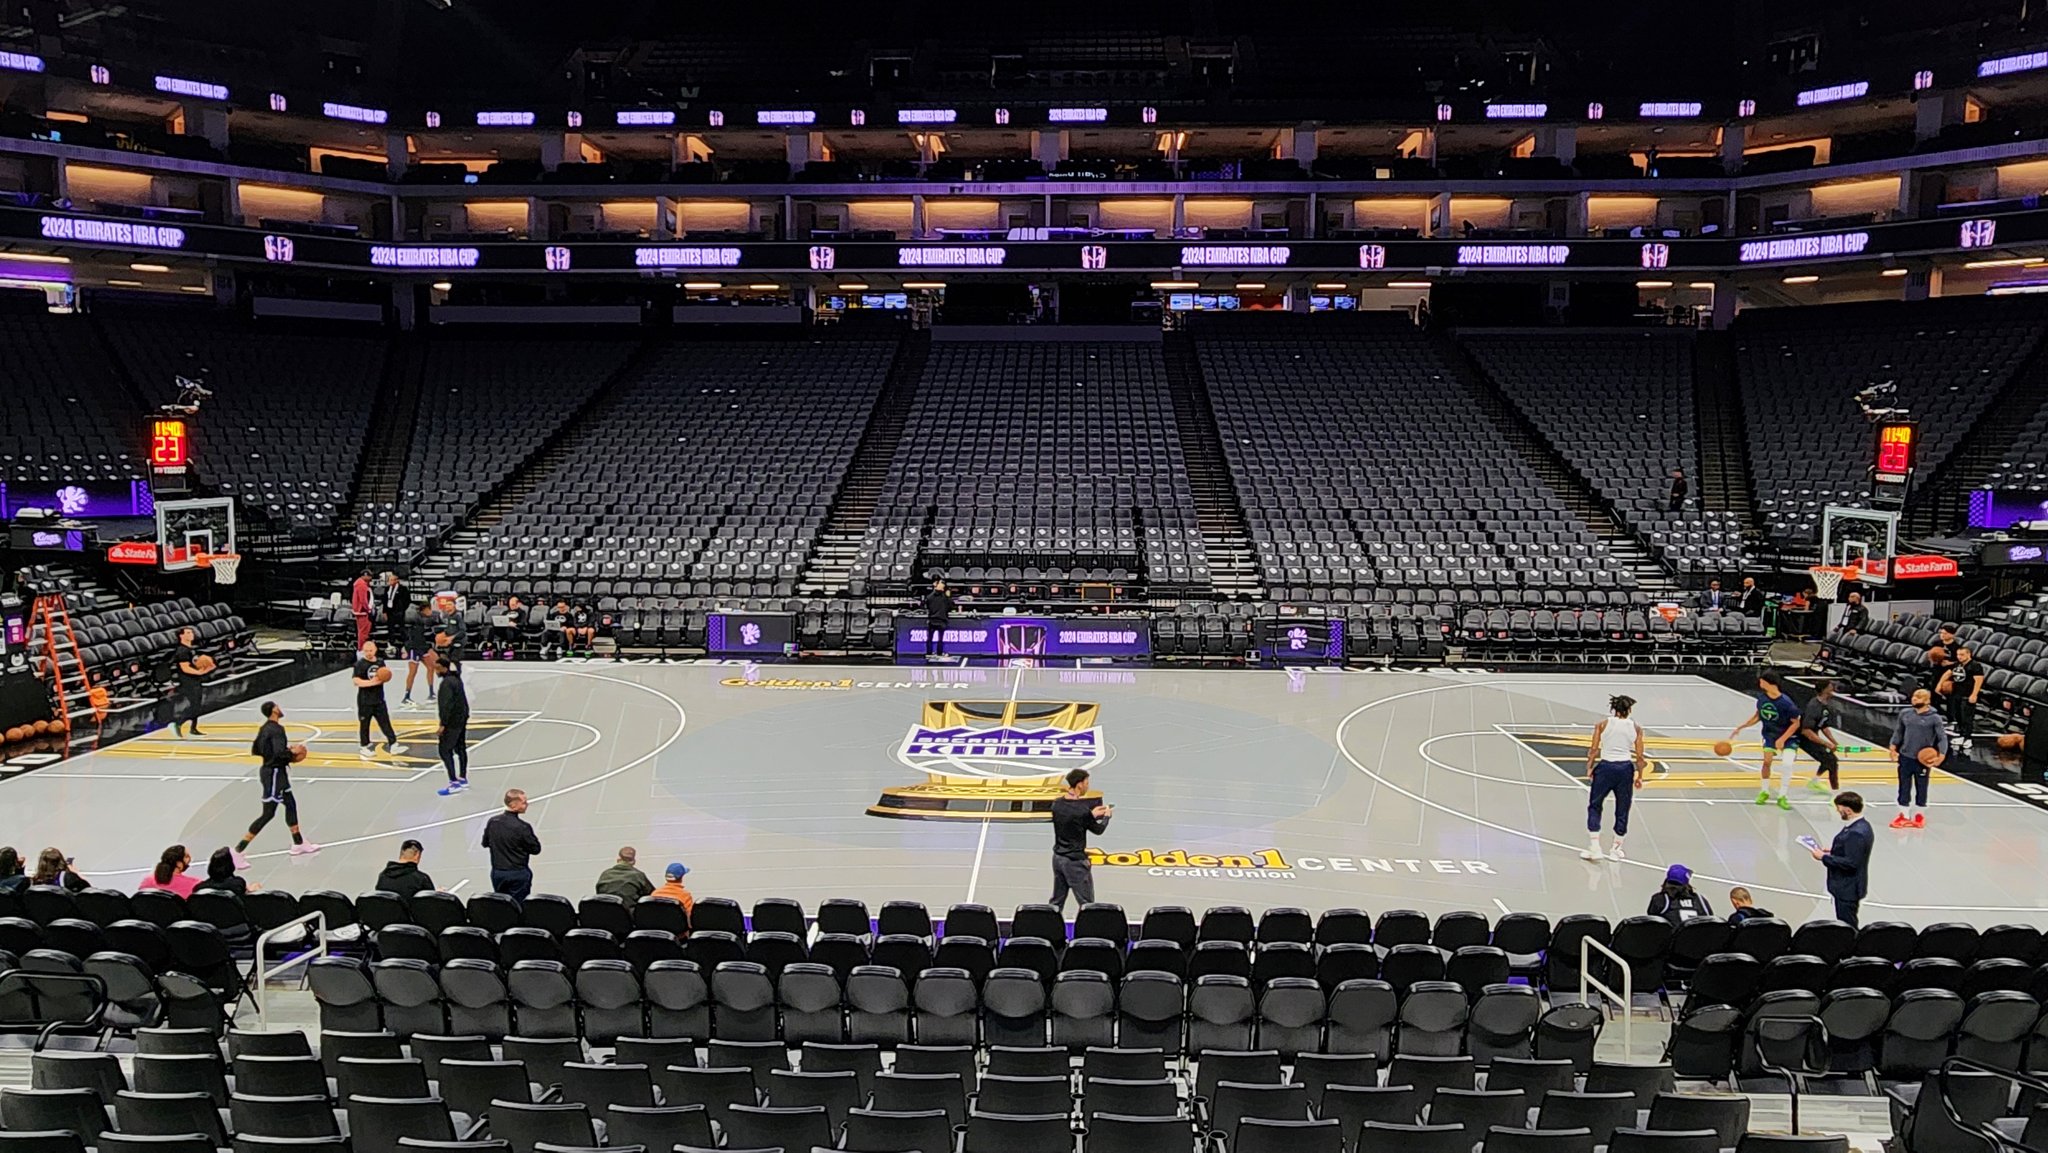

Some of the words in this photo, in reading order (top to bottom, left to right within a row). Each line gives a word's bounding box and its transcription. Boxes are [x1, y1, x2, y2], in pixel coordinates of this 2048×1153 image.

[41, 217, 73, 238] 2024
[74, 219, 132, 243] EMIRATES
[132, 224, 158, 246] NBA
[158, 227, 184, 247] CUP
[1458, 246, 1482, 263] 2024
[1483, 246, 1528, 263] EMIRATES
[1528, 246, 1548, 263] NBA
[1549, 246, 1569, 263] CUP
[1740, 242, 1768, 261] 2024
[1769, 237, 1819, 259] EMIRATES
[1820, 234, 1843, 255] NBA
[1844, 233, 1868, 252] CUP
[371, 247, 396, 265] 2024
[397, 248, 439, 266] EMIRATES
[440, 248, 459, 266] NBA
[459, 248, 479, 266] CUP
[635, 248, 658, 265] 2024
[659, 248, 701, 265] EMIRATES
[701, 248, 720, 265] NBA
[721, 248, 741, 265] CUP
[899, 248, 922, 264] 2024
[922, 248, 965, 264] EMIRATES
[966, 248, 985, 264] NBA
[986, 248, 1005, 264] CUP
[1181, 247, 1204, 264] 2024
[1205, 247, 1250, 264] EMIRATES
[1250, 247, 1269, 264] NBA
[1270, 247, 1290, 264] CUP
[155, 437, 179, 462] 23
[125, 548, 146, 558] State
[910, 630, 927, 641] 2024
[959, 630, 972, 642] NBA
[973, 630, 987, 642] CUP
[1059, 631, 1076, 643] 2024
[1077, 631, 1108, 643] EMIRATES
[1108, 631, 1122, 643] NBA
[1123, 631, 1137, 643] CUP
[918, 744, 1096, 756] KINGS
[1147, 867, 1220, 877] Credit
[1227, 868, 1296, 880] Union
[1297, 858, 1497, 874] CENTER
